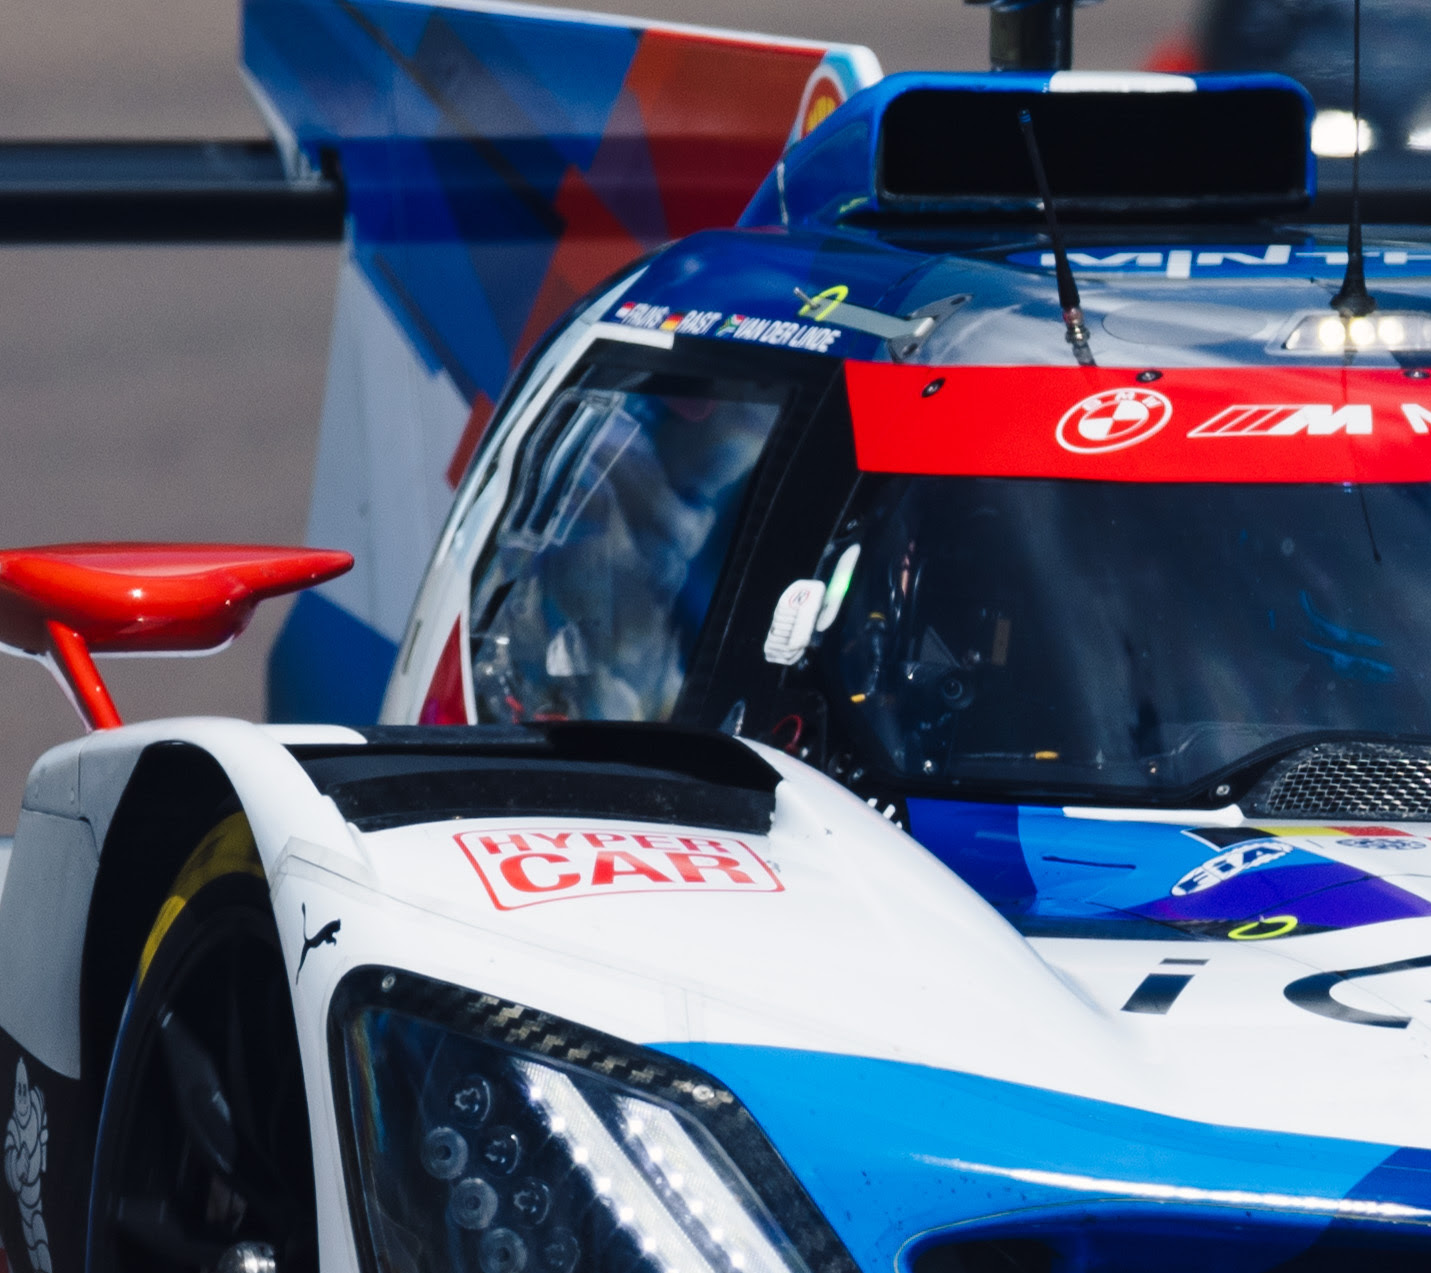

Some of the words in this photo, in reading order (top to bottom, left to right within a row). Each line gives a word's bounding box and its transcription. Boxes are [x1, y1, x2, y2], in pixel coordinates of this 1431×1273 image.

[676, 310, 722, 335] RAST
[733, 316, 771, 341] VAN
[788, 325, 841, 352] LINDE
[478, 832, 735, 855] HYPER
[499, 850, 756, 894] CAR
[1177, 845, 1286, 892] FIA
